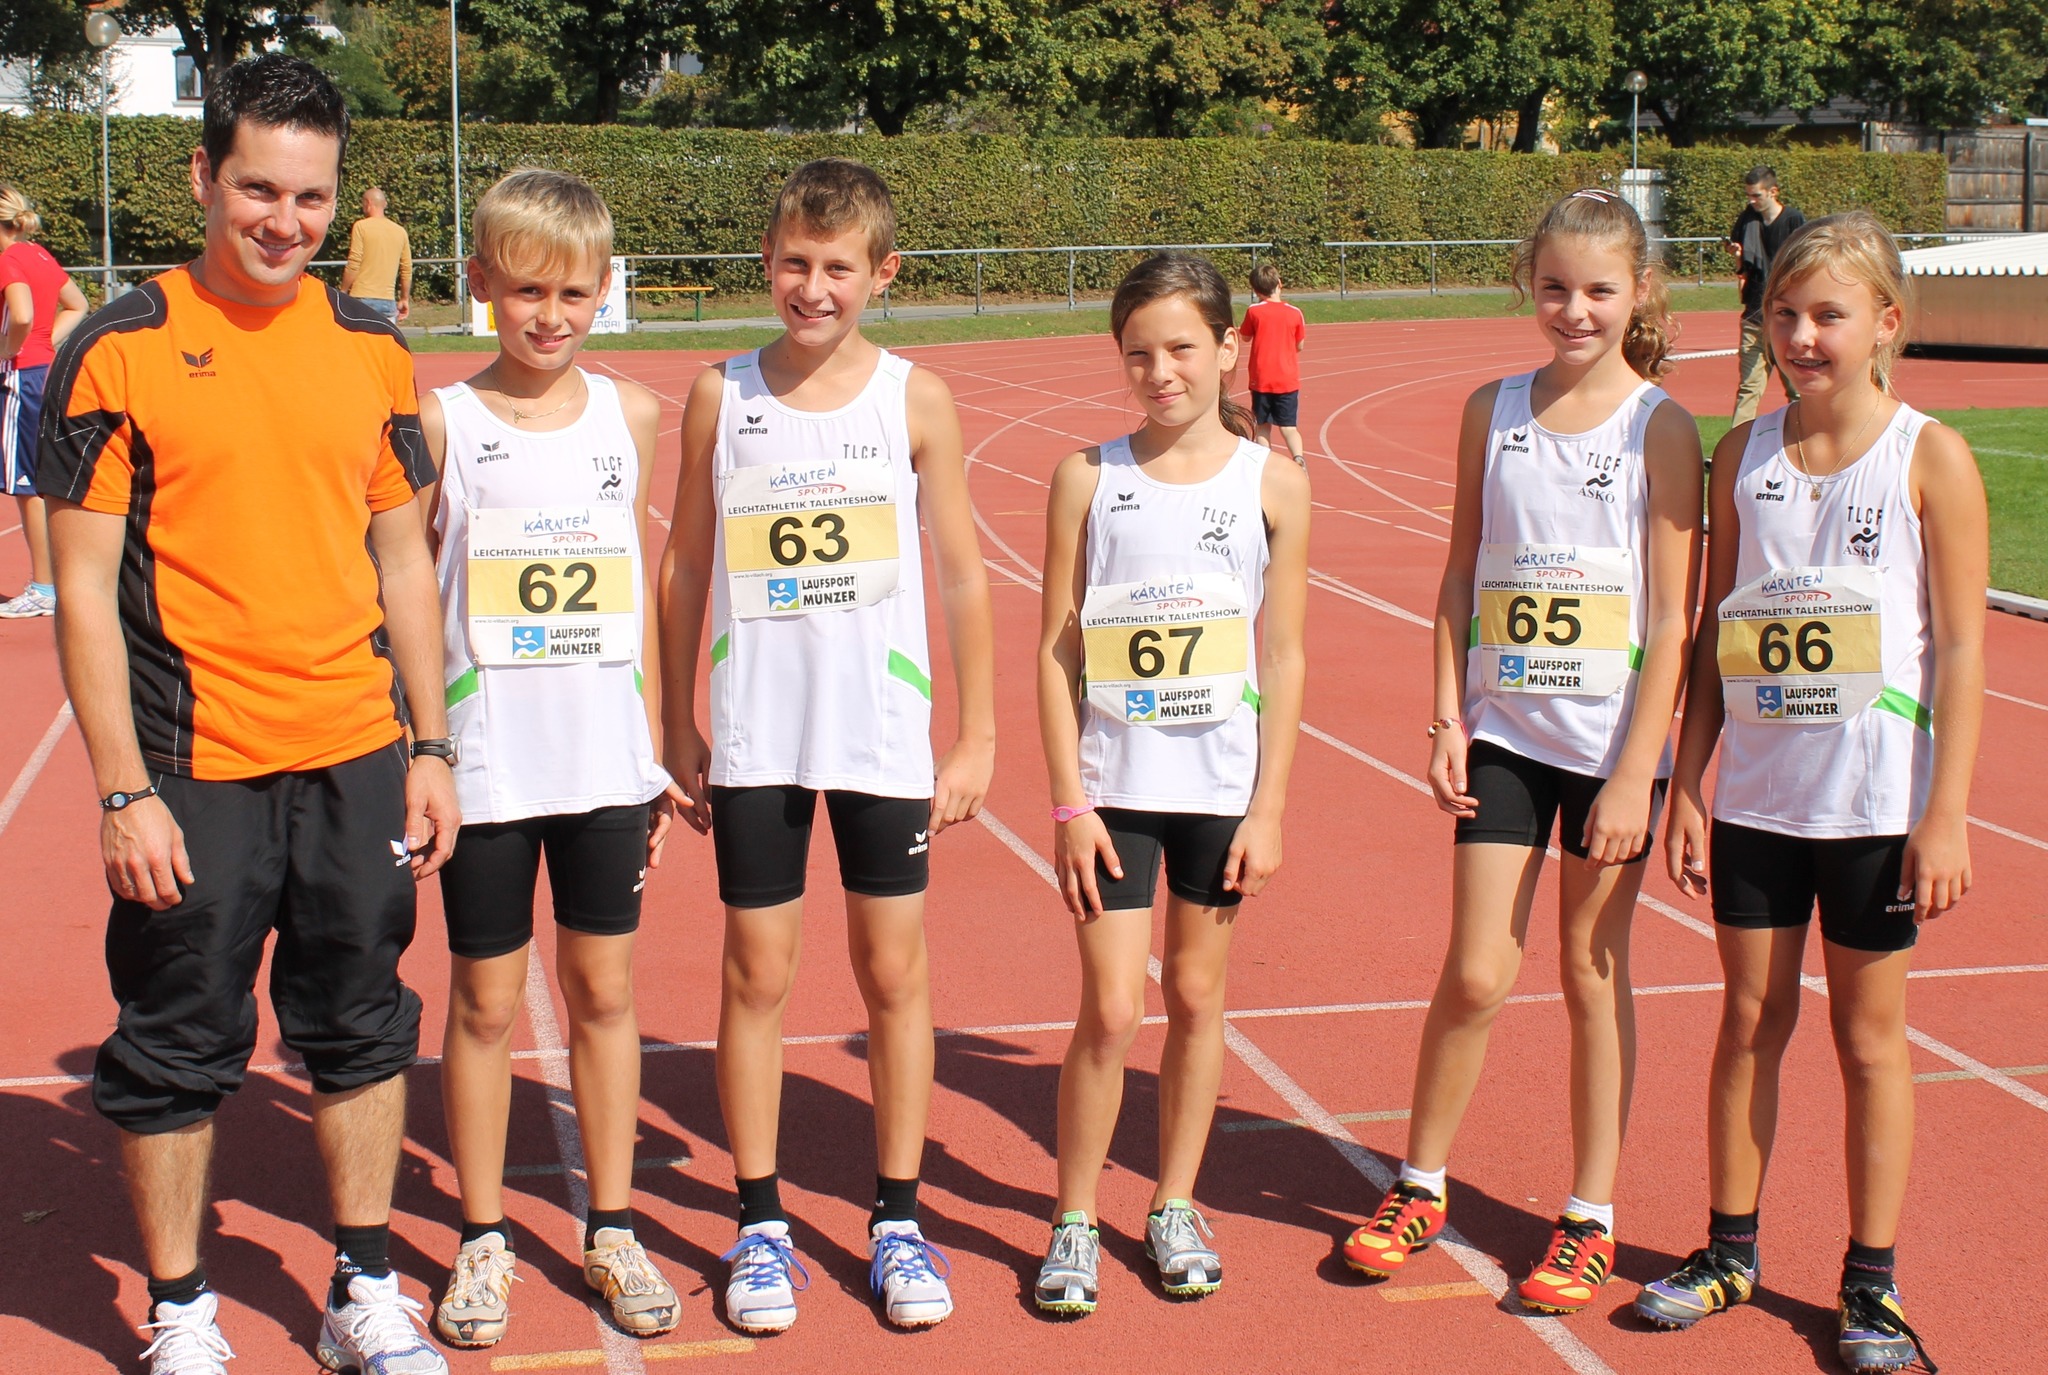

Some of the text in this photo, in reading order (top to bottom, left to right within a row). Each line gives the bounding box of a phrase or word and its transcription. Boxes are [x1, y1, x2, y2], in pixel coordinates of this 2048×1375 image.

[189, 370, 216, 378] erima
[738, 426, 768, 435] erima
[1503, 443, 1529, 453] erima
[477, 451, 510, 464] erima
[798, 486, 834, 496] SPORT
[1756, 492, 1784, 502] erima
[728, 495, 888, 515] LEICHTATHLETIK TALENTESHOW
[1110, 503, 1140, 512] erima
[552, 534, 588, 543] SPORT
[769, 513, 849, 566] 63
[474, 547, 626, 557] LEICHTATHLETIK TALENTESHOW
[1536, 568, 1573, 579] SPORT
[519, 562, 598, 614] 62
[802, 576, 855, 589] LAUFSPORT
[1481, 580, 1624, 593] LEICHTATHLETIK TALENTESHOW
[803, 590, 856, 606] MÜNZER
[1784, 592, 1819, 602] SPORT
[1156, 600, 1192, 610] SPORT
[1723, 604, 1873, 619] LEICHTATHLETIK TALENTESHOW
[1087, 608, 1241, 626] LEICHTATHLETIK TALENTESHOW
[1507, 595, 1581, 646] 65
[550, 627, 600, 639] LAUFSPORT
[550, 639, 601, 656] MÜNZER
[1129, 626, 1204, 678] 67
[1758, 621, 1833, 673] 66
[1528, 659, 1582, 672] LAUFSPORT
[1527, 670, 1581, 687] MÜNZER
[1159, 689, 1211, 702] LAUFSPORT
[1785, 687, 1836, 699] LAUFSPORT
[1160, 702, 1212, 718] MÜNZER
[1786, 700, 1838, 716] MÜNZER
[908, 843, 928, 855] erim
